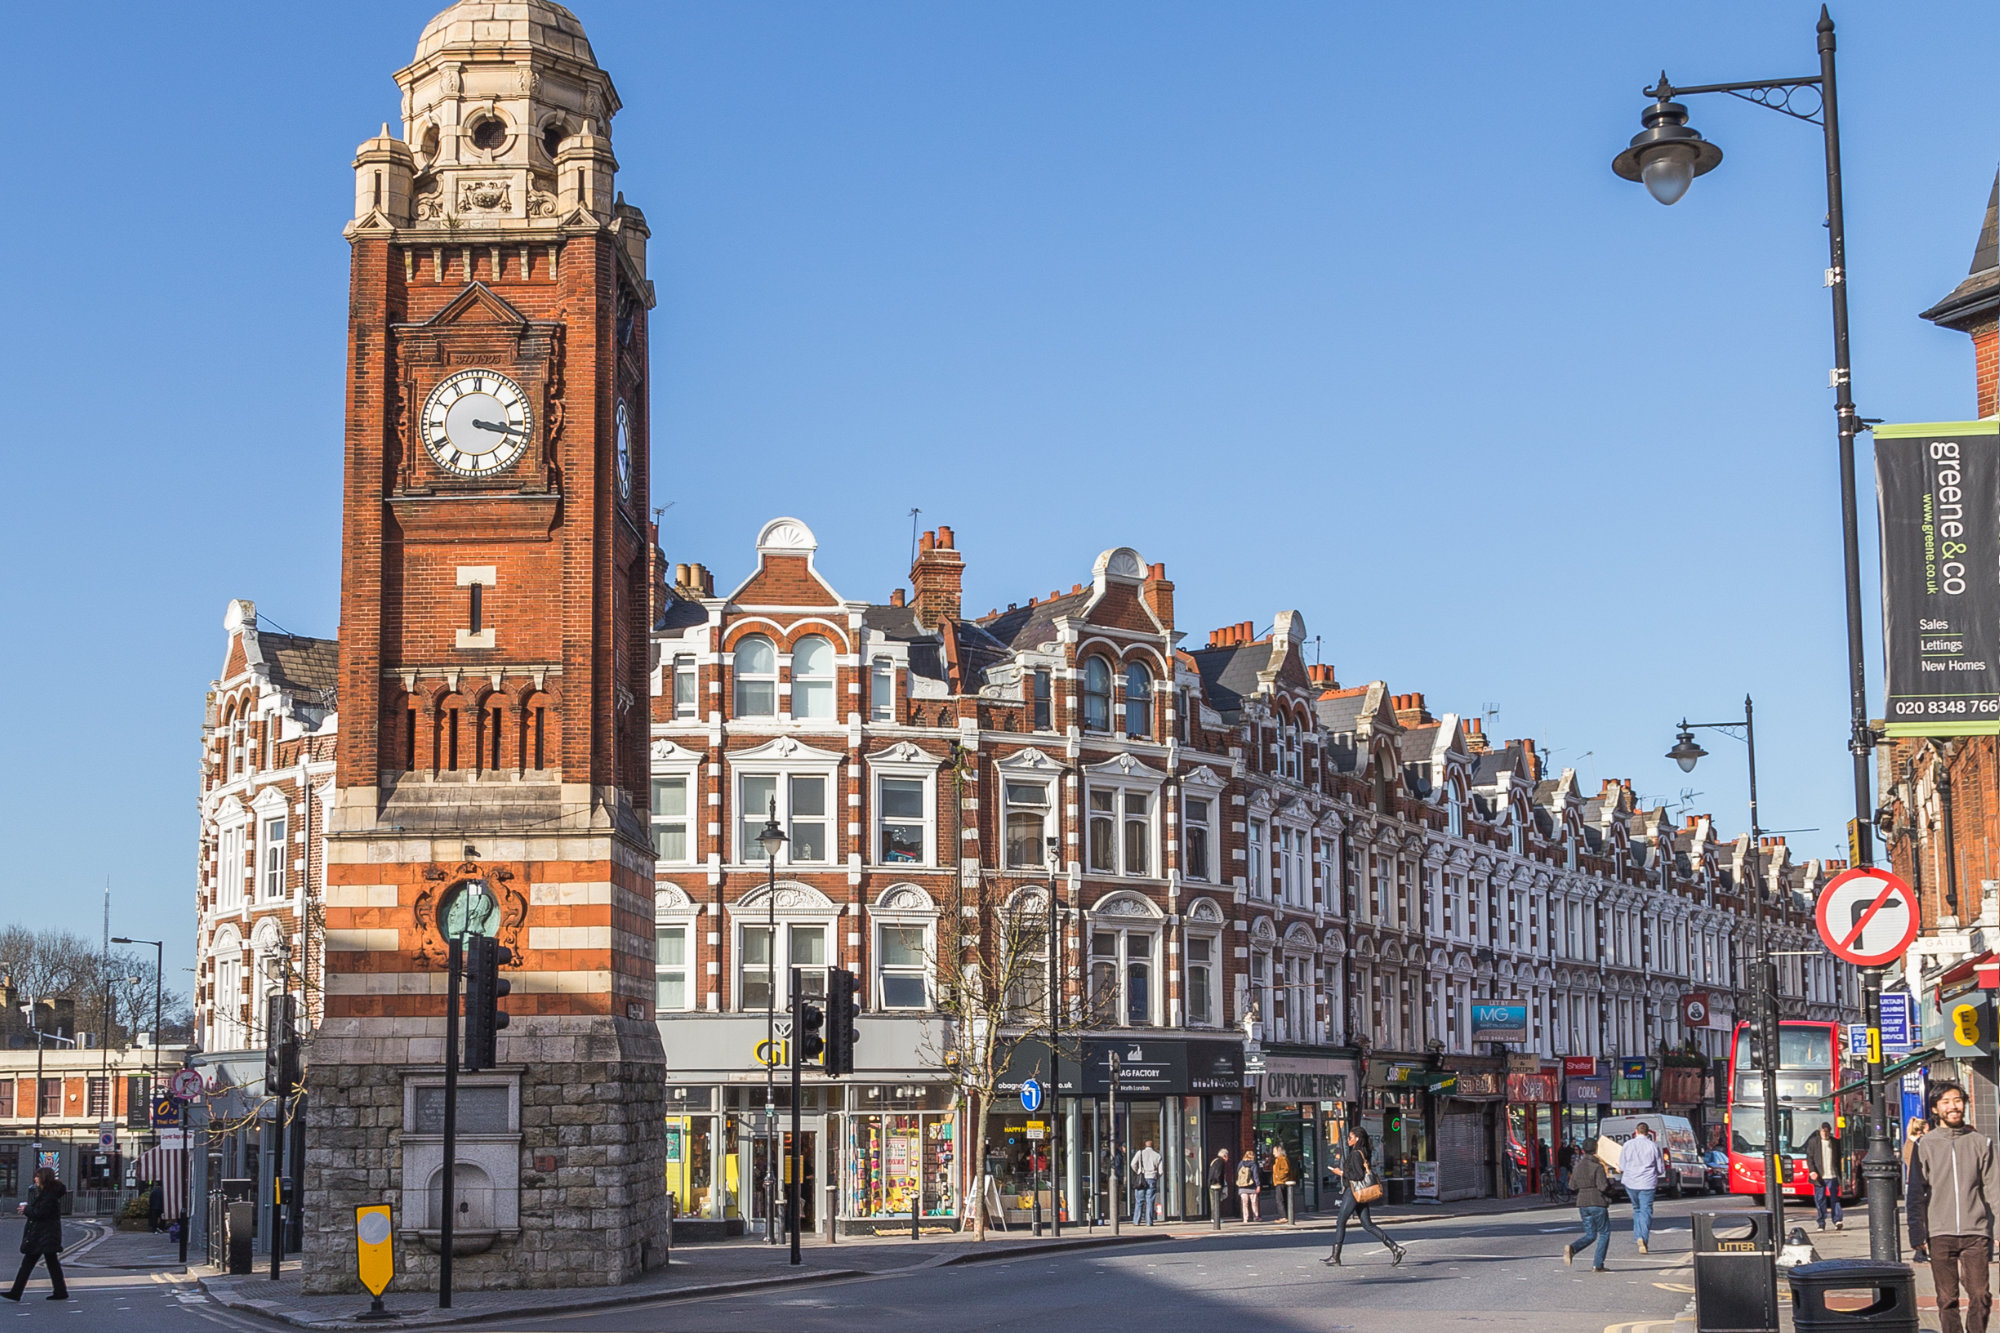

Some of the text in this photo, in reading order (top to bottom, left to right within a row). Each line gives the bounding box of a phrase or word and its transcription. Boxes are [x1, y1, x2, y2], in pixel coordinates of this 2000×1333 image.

[1930, 442, 1967, 595] greene & co
[1922, 494, 1939, 595] www.greene.co.uk
[1920, 618, 1949, 630] Sales
[1921, 640, 1963, 652] Lettings
[1922, 660, 1986, 672] New Homes
[1896, 702, 1924, 714] 020
[1928, 700, 1966, 714] 8348
[1481, 1008, 1508, 1021] MG
[1578, 1086, 1598, 1098] CORAL
[1804, 1082, 1818, 1096] 91
[1718, 1242, 1756, 1252] LITTER
